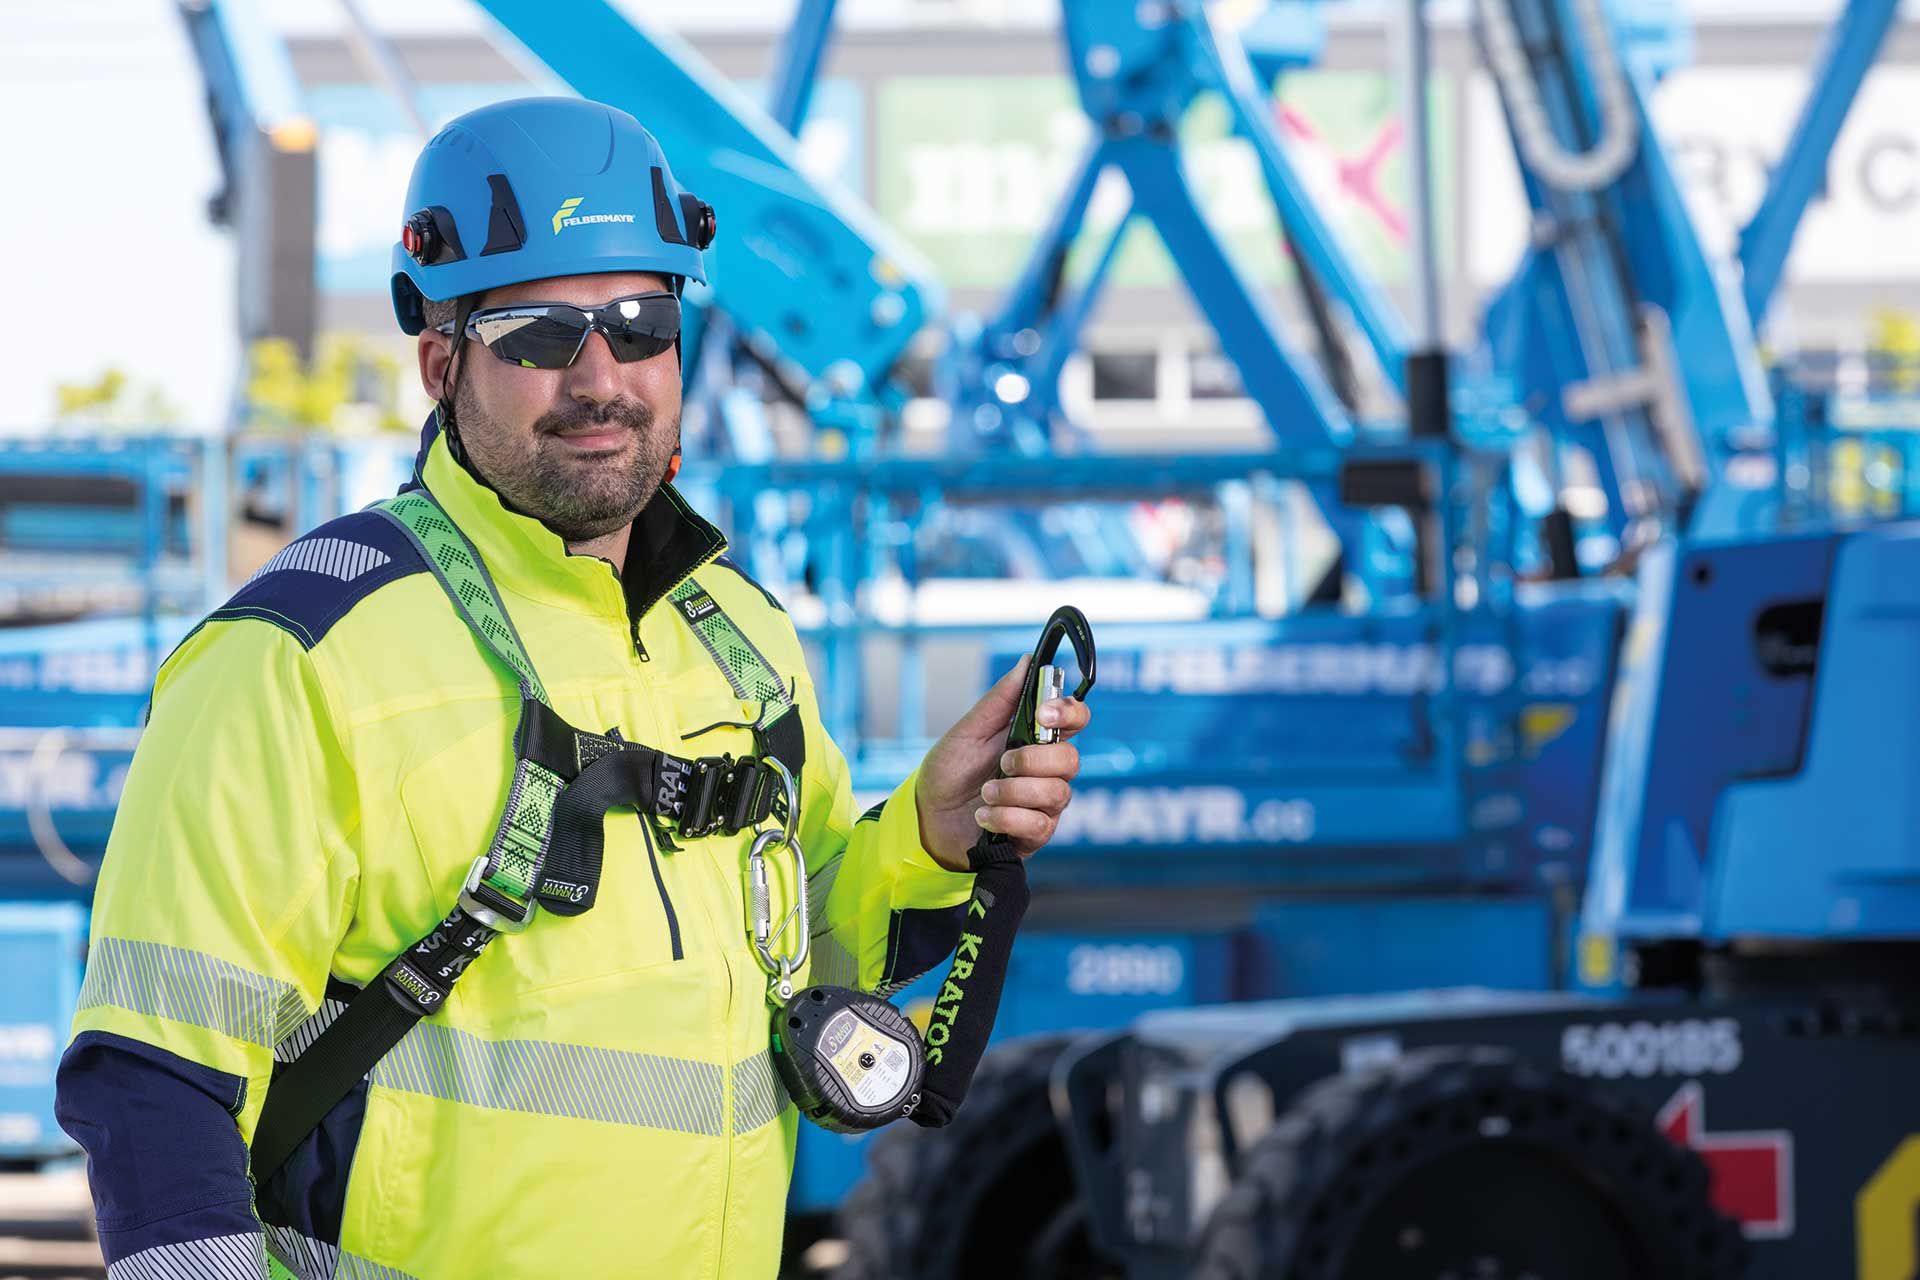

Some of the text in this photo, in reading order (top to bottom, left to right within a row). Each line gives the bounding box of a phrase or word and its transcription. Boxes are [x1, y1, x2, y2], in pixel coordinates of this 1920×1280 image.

[563, 214, 635, 227] FELBERMAYR
[541, 885, 573, 898] KRATOS
[394, 971, 422, 997] KRATOS
[1561, 1018, 1743, 1079] 500185
